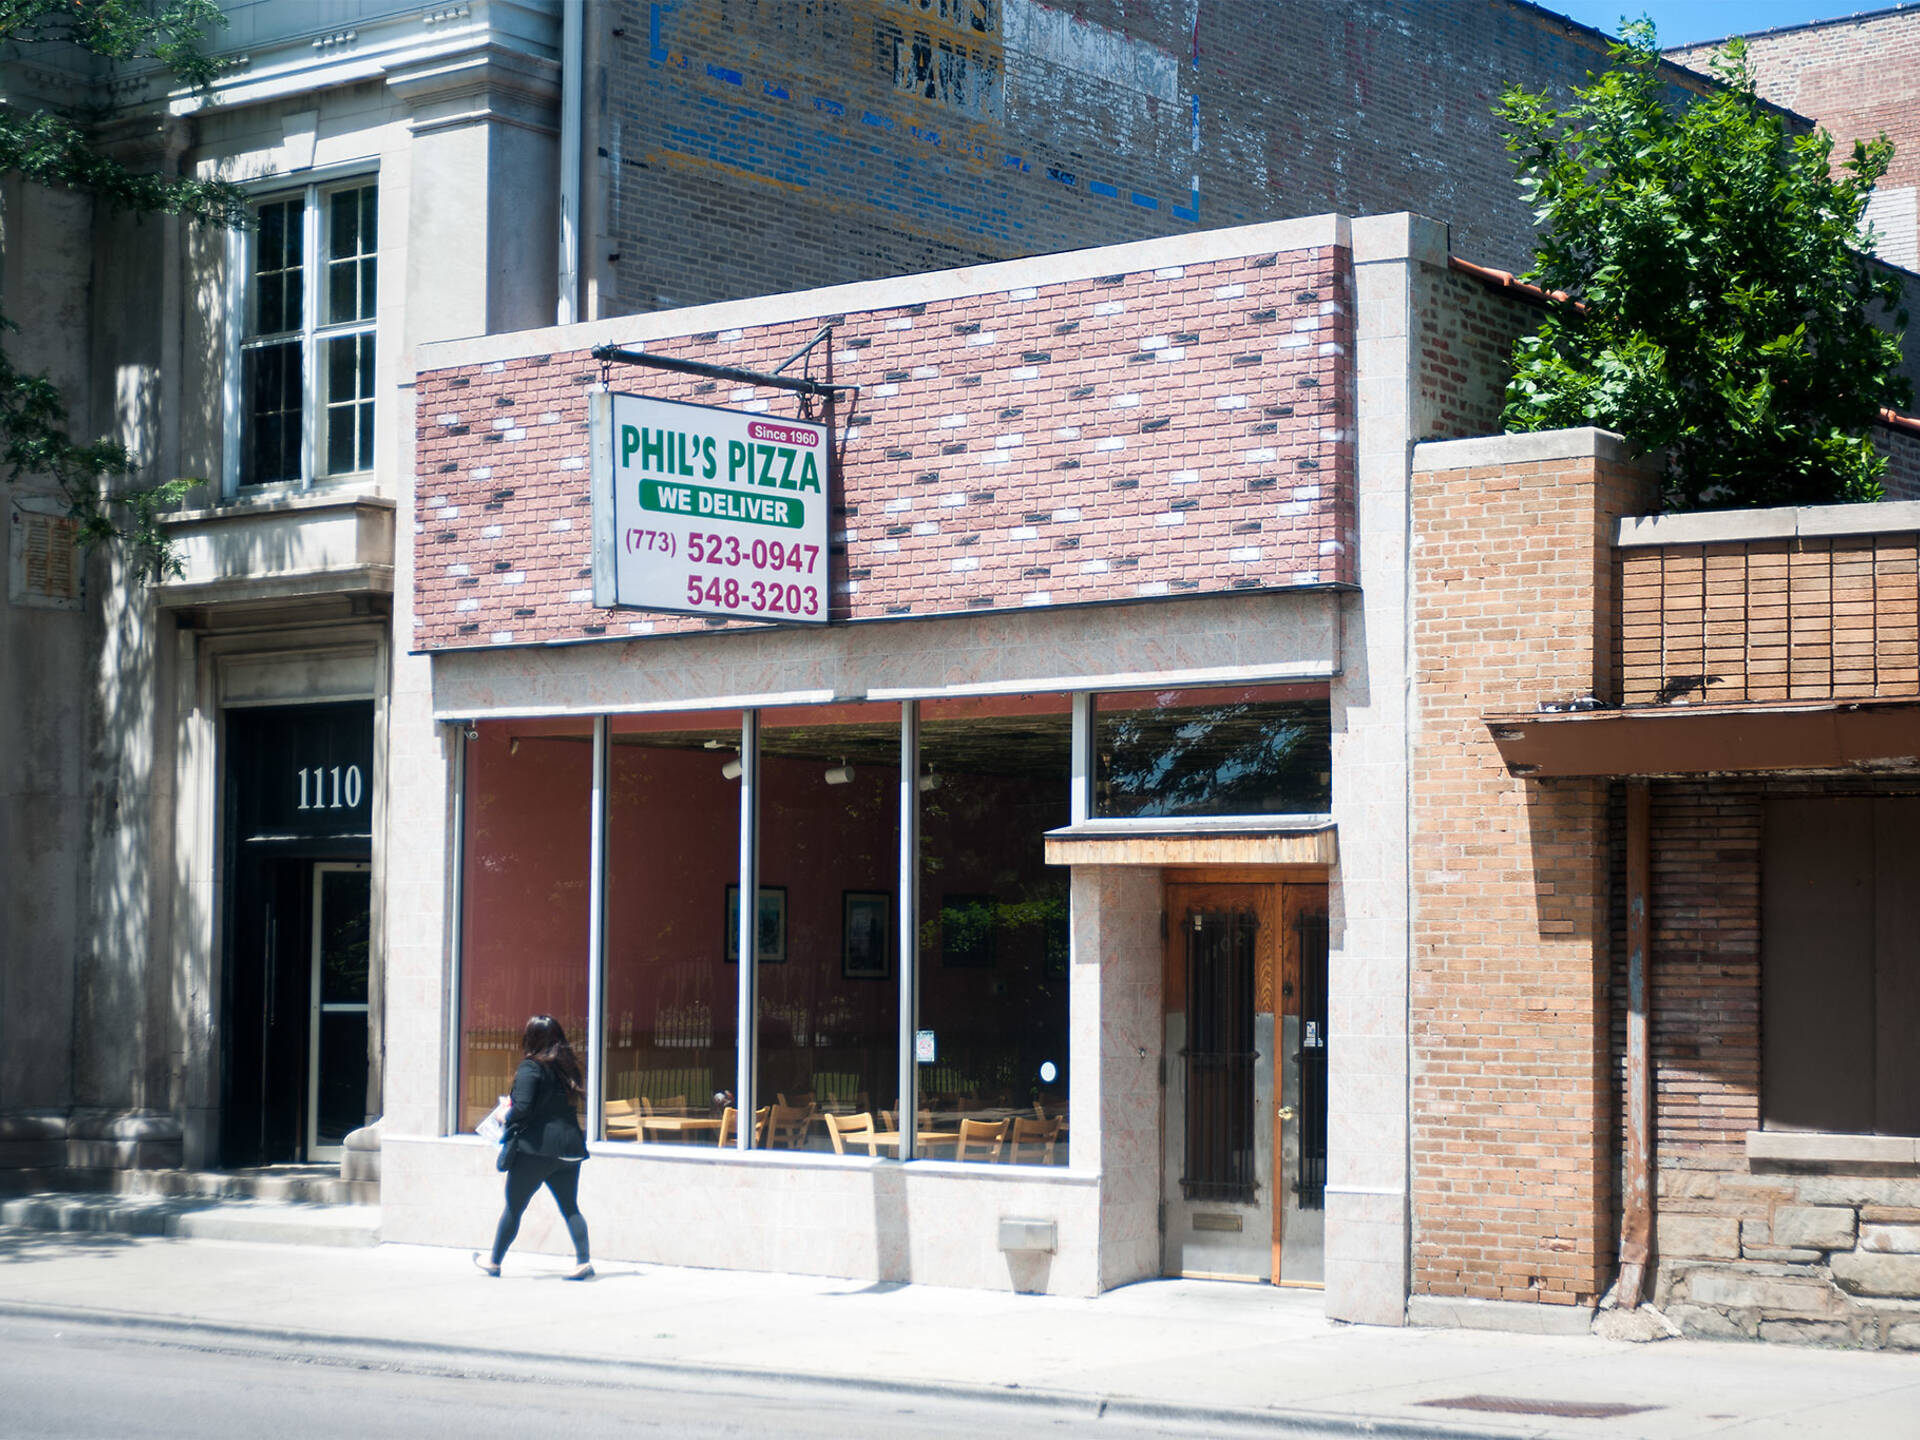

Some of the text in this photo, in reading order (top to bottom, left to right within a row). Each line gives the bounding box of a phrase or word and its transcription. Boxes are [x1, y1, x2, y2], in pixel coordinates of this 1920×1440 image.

[754, 425, 816, 445] Since 1960
[621, 424, 821, 494] PHIL'S PIZZA
[657, 486, 789, 523] WE DELIVER
[625, 528, 820, 574] (773) 523-0947
[686, 574, 819, 615] 548-3203
[297, 764, 362, 809] 1110
